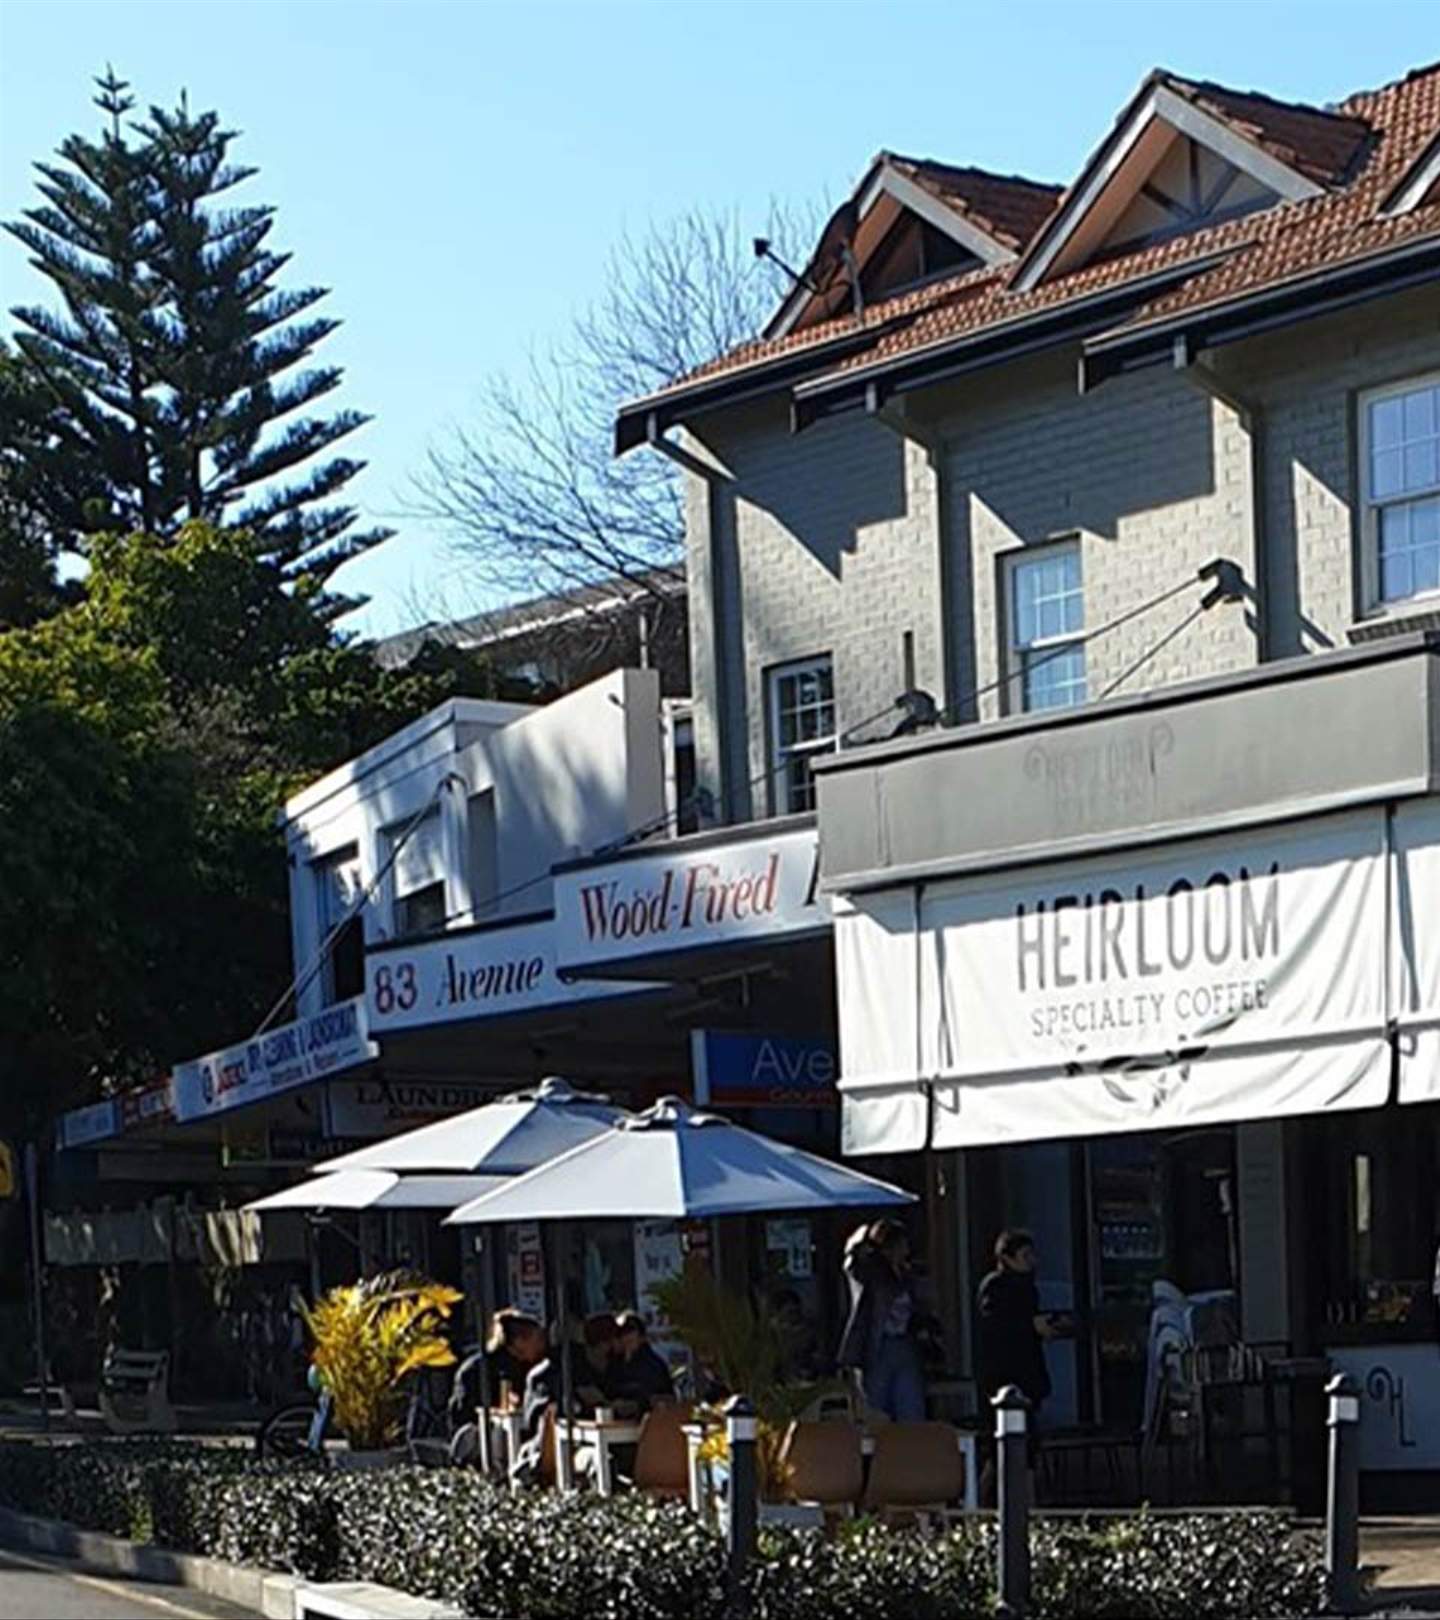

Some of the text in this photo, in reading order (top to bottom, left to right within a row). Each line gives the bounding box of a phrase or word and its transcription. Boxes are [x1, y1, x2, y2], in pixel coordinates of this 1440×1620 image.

[580, 854, 779, 943] Wood-Fired
[1017, 861, 1279, 992] HEIRLOOM
[374, 954, 544, 1014] 83 Avenue
[1030, 979, 1269, 1037] SPECIALTY COFFEE
[752, 1039, 835, 1082] Ave
